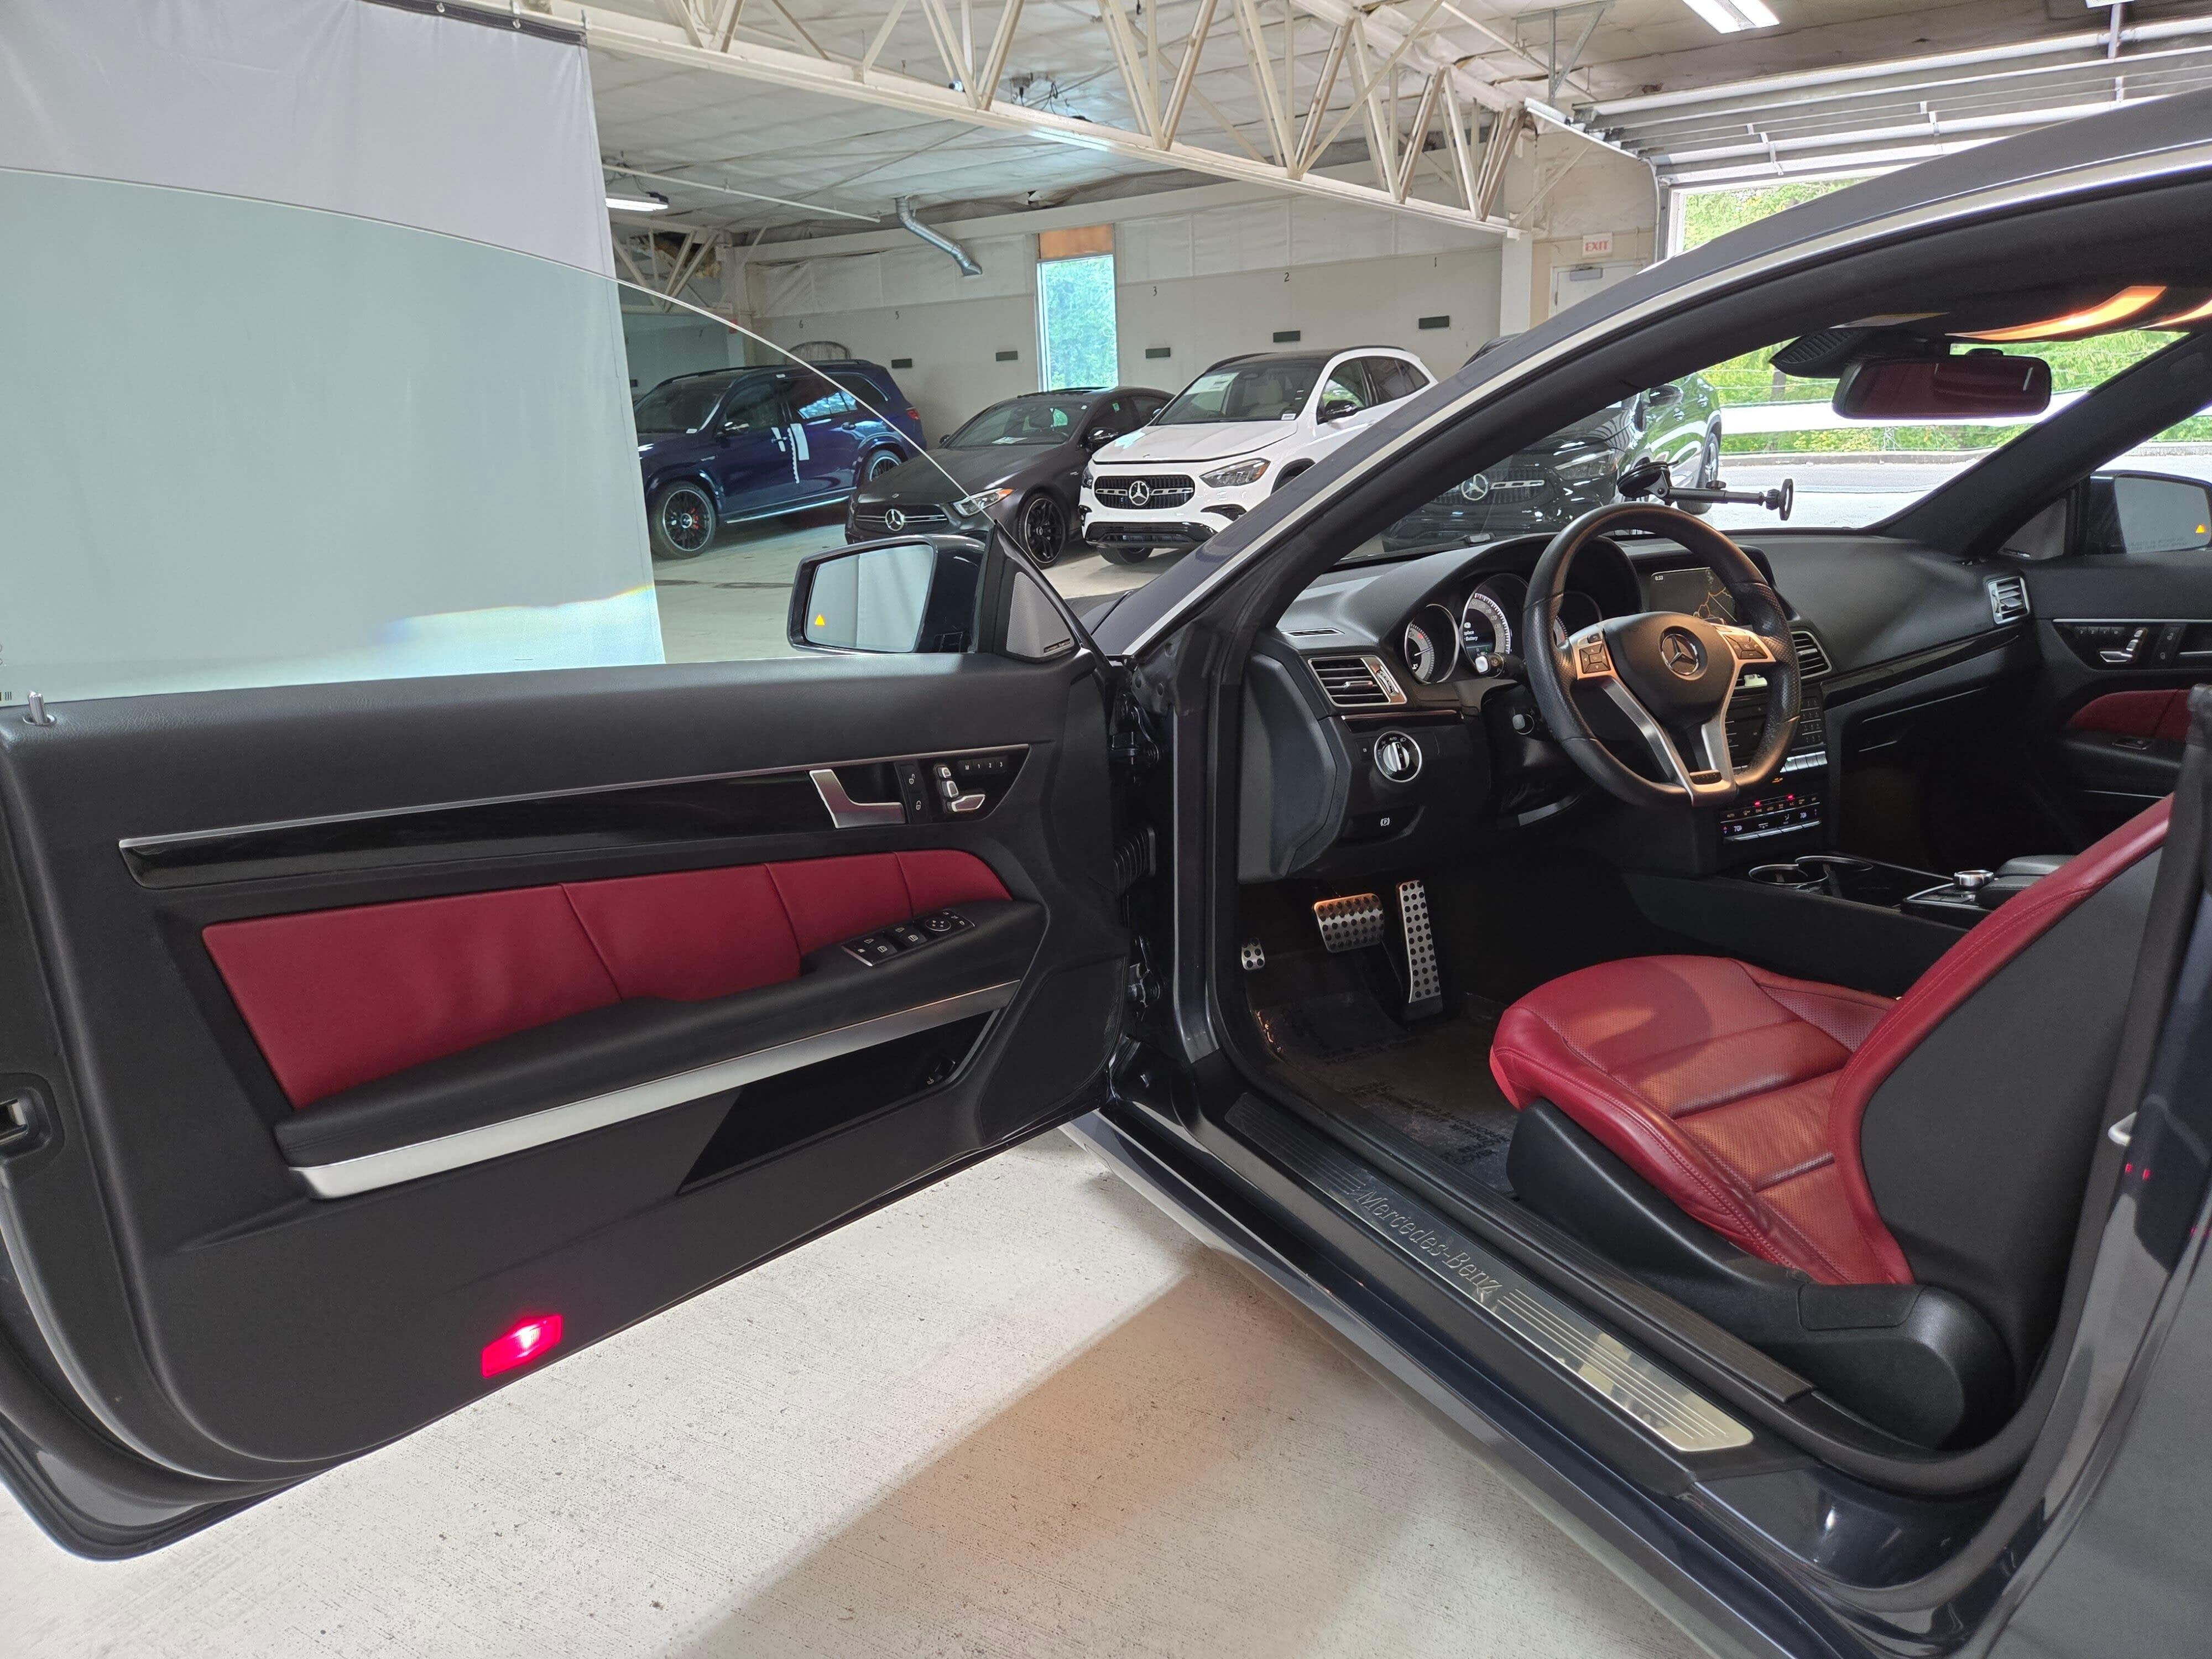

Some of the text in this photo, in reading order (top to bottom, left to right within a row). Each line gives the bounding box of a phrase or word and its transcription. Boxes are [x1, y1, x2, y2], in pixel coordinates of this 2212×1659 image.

[1585, 240, 1609, 252] EXIT
[1284, 272, 1290, 282] 2
[1152, 286, 1157, 296] 3
[895, 311, 899, 320] 5
[799, 320, 803, 328] 6
[1354, 1190, 1503, 1295] Mercedes-Benz
